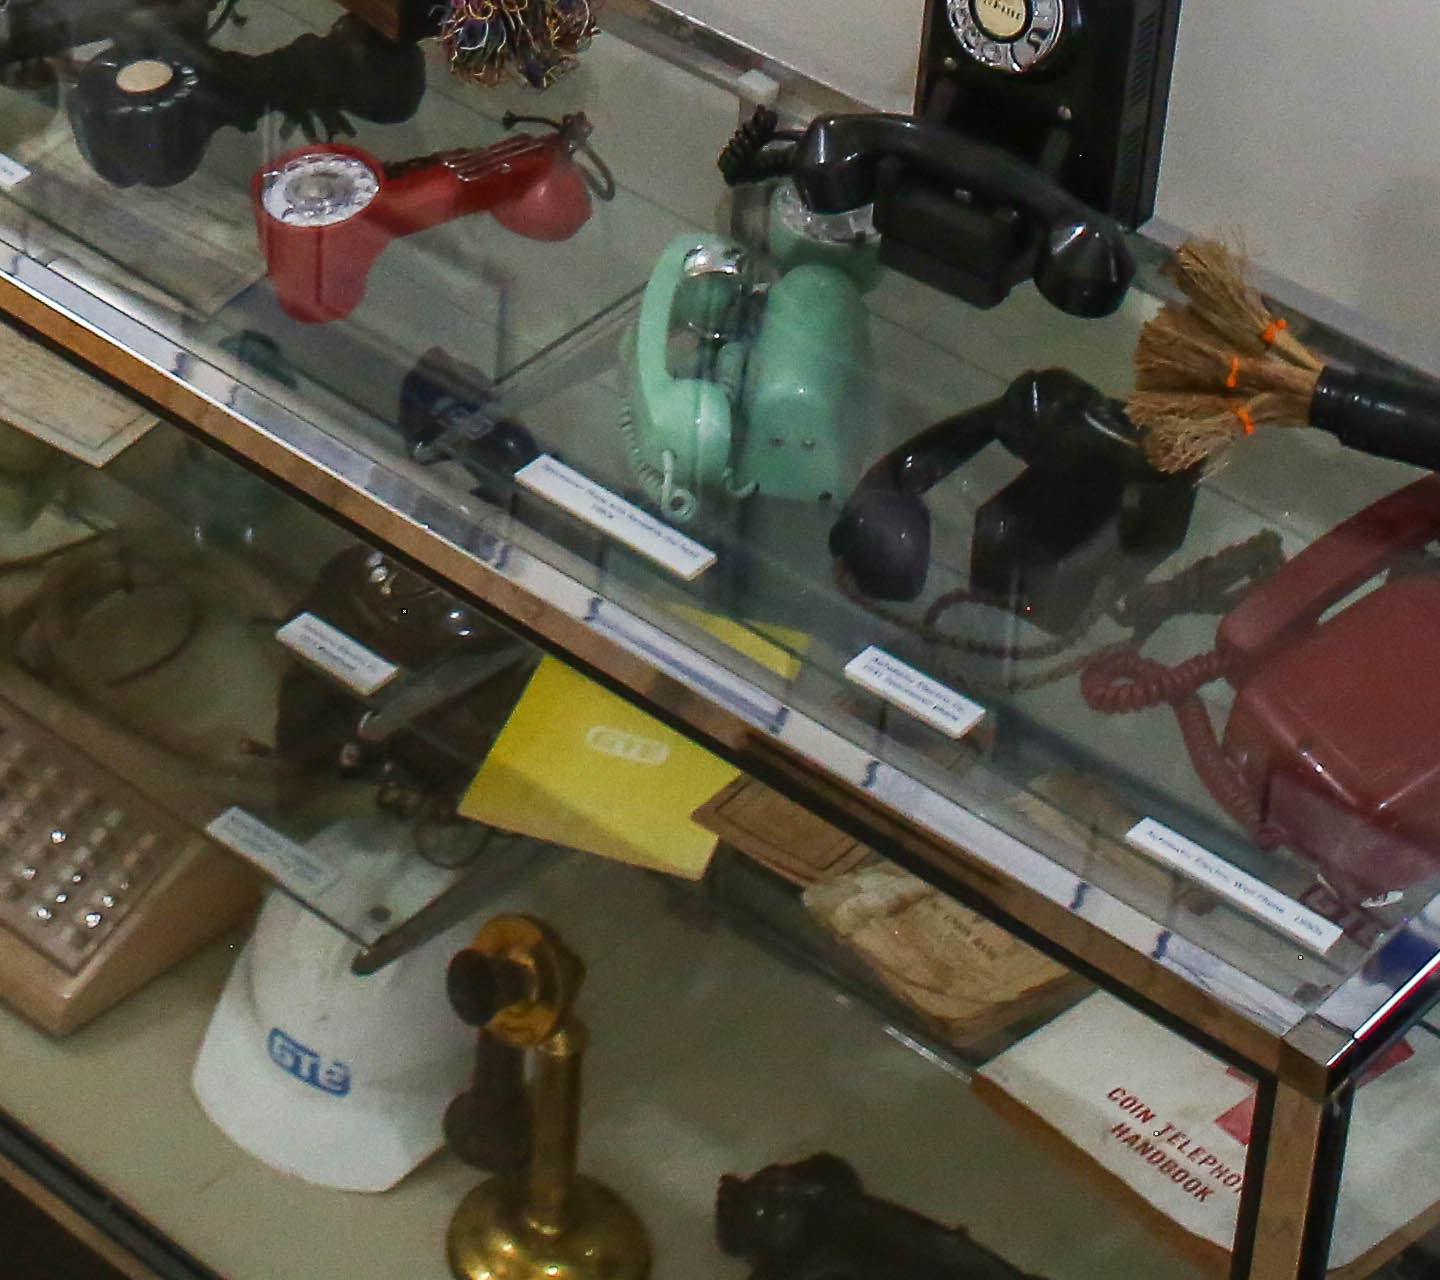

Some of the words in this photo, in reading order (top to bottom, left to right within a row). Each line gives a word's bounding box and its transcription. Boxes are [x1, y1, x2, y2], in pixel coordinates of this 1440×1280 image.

[1107, 1087, 1157, 1124] COIN
[1156, 1121, 1244, 1194] TELEPHO
[1109, 1122, 1215, 1203] HANDBOOK
